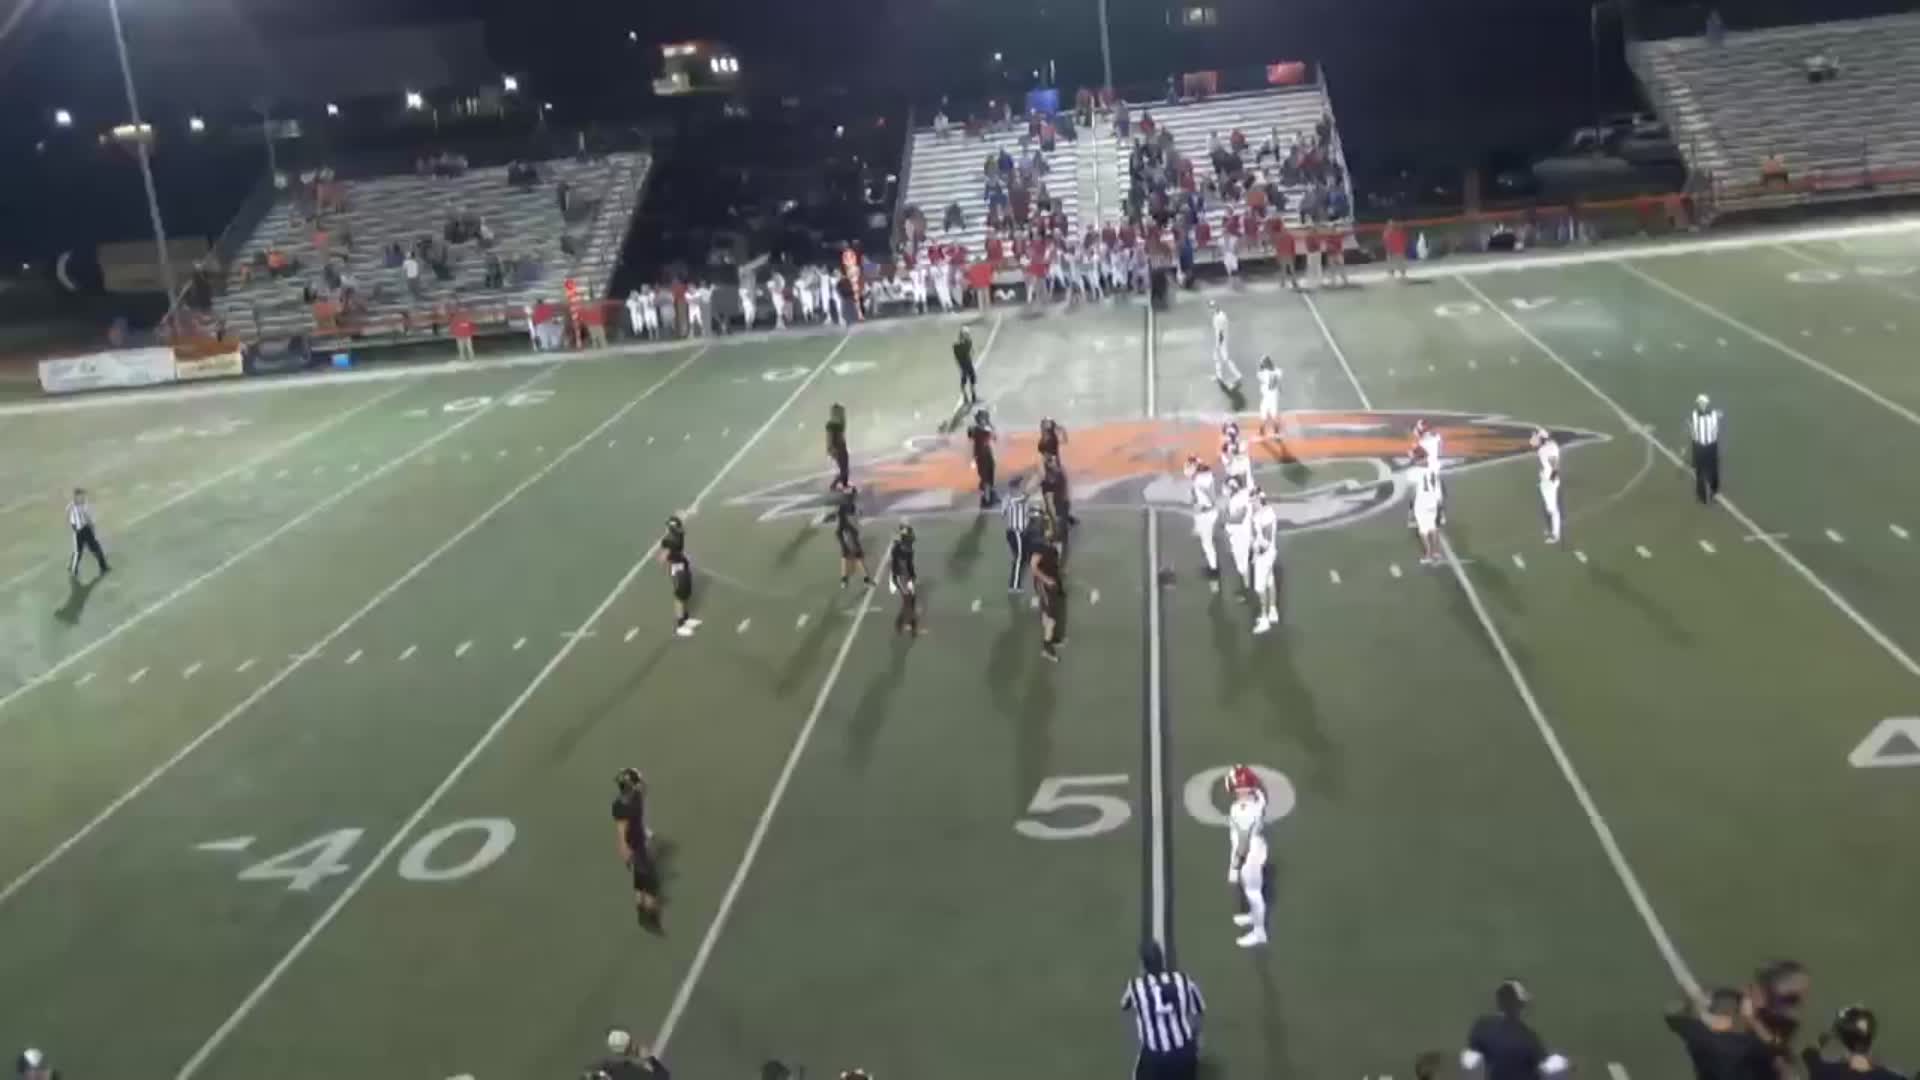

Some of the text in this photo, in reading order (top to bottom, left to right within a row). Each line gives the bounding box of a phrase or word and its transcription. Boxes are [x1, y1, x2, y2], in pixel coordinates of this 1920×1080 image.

[1014, 764, 1297, 841] 50
[236, 817, 517, 893] 40
[1151, 984, 1174, 1014] L
